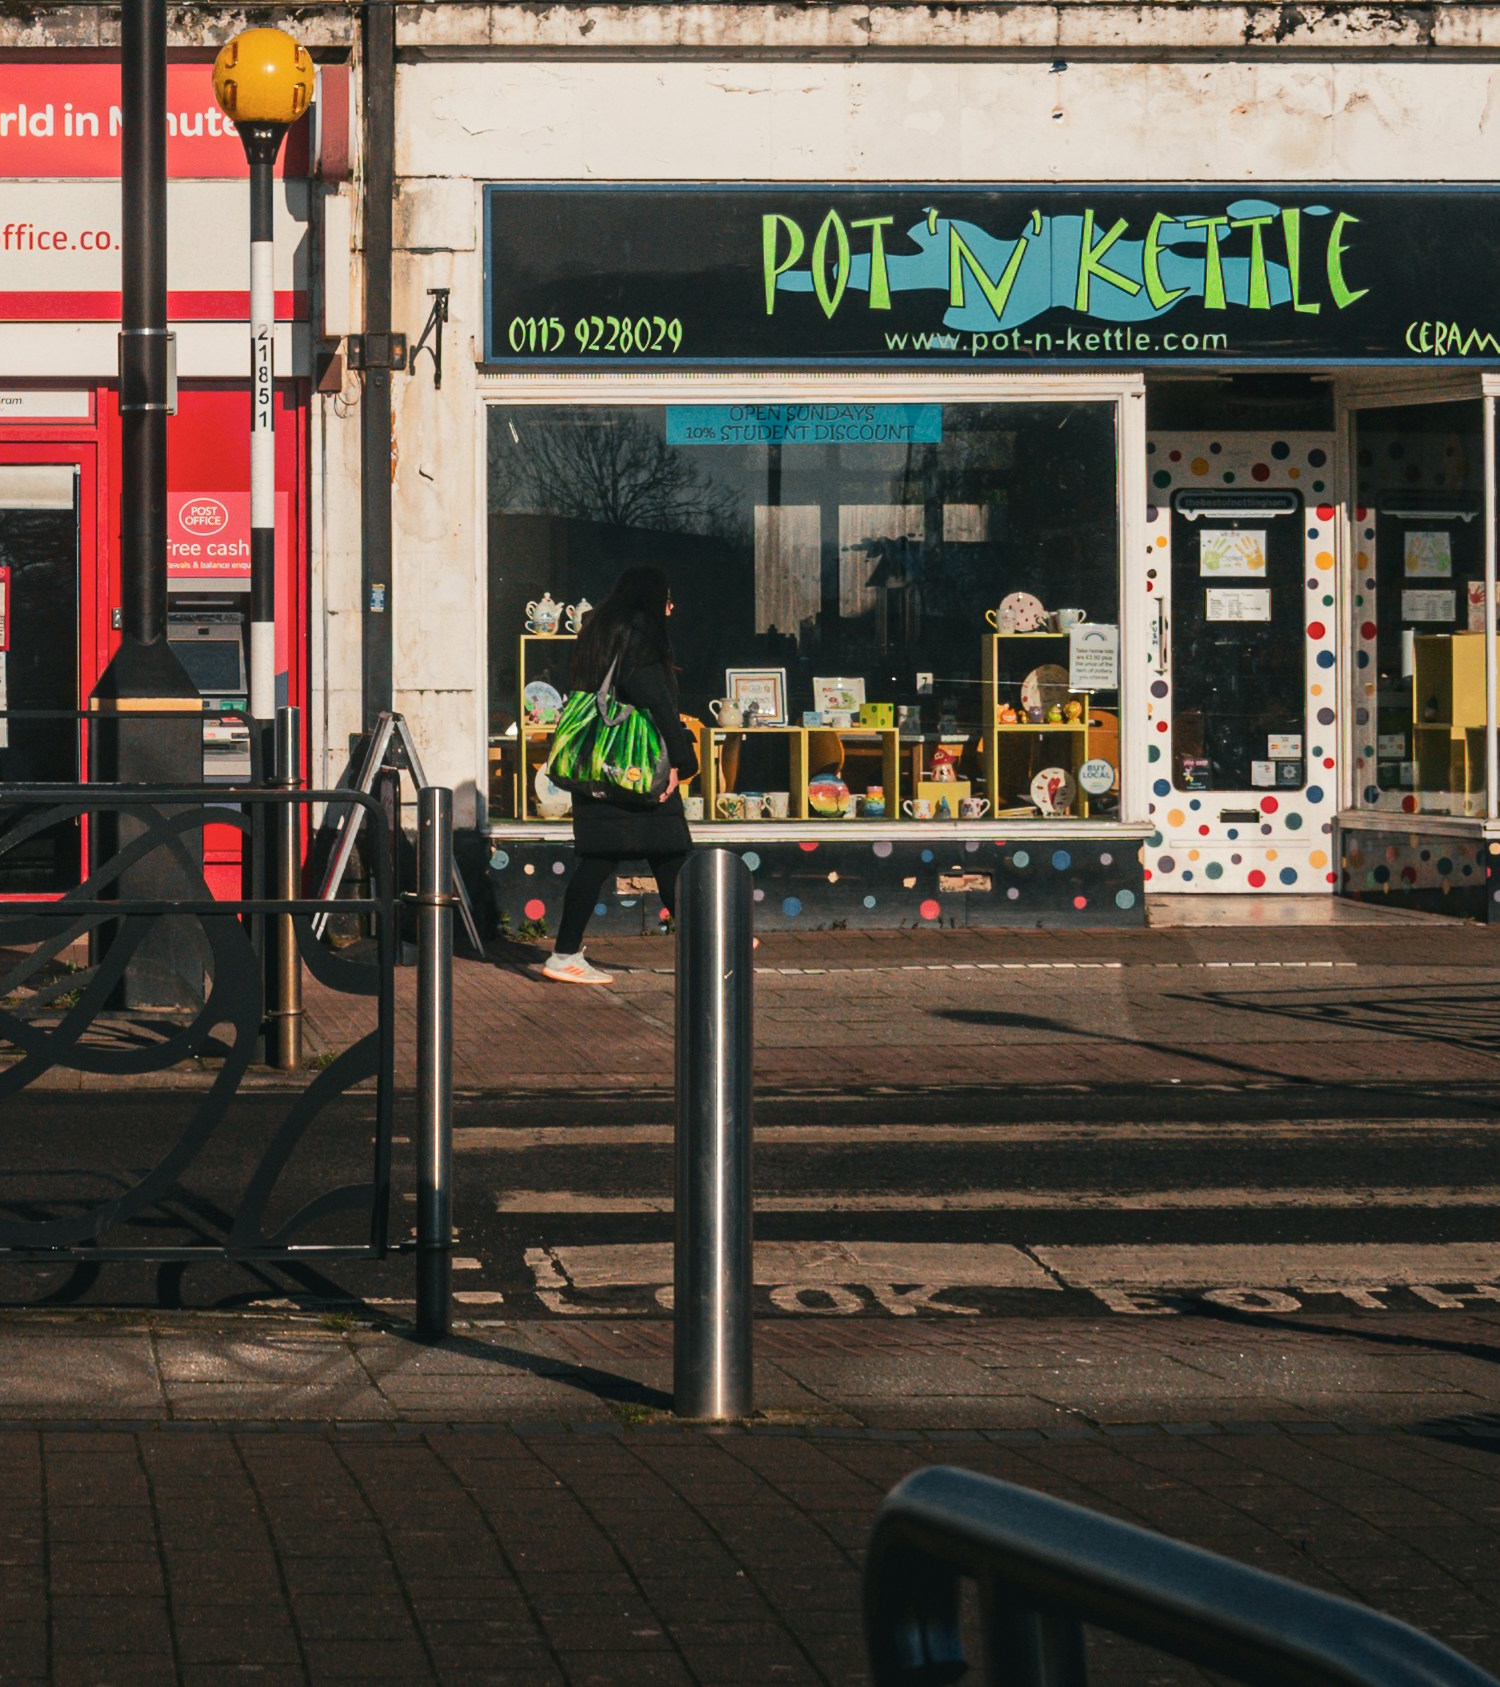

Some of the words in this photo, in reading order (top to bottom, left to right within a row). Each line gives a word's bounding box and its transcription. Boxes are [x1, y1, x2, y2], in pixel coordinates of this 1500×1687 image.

[64, 104, 99, 138] in
[762, 208, 894, 320] POT
[1075, 207, 1371, 315] KETTLE
[509, 316, 565, 353] 0115
[575, 315, 683, 354] 9228029
[884, 327, 1228, 356] www.pot-n-kettle.com
[729, 405, 783, 422] OPEN
[786, 405, 876, 422] SUNDAYS
[685, 426, 716, 441] 10%
[721, 424, 811, 442] STUDENT
[814, 424, 915, 442] DISCOUNT
[191, 507, 217, 515] POST
[185, 517, 221, 526] OFFICE
[206, 540, 250, 556] cash
